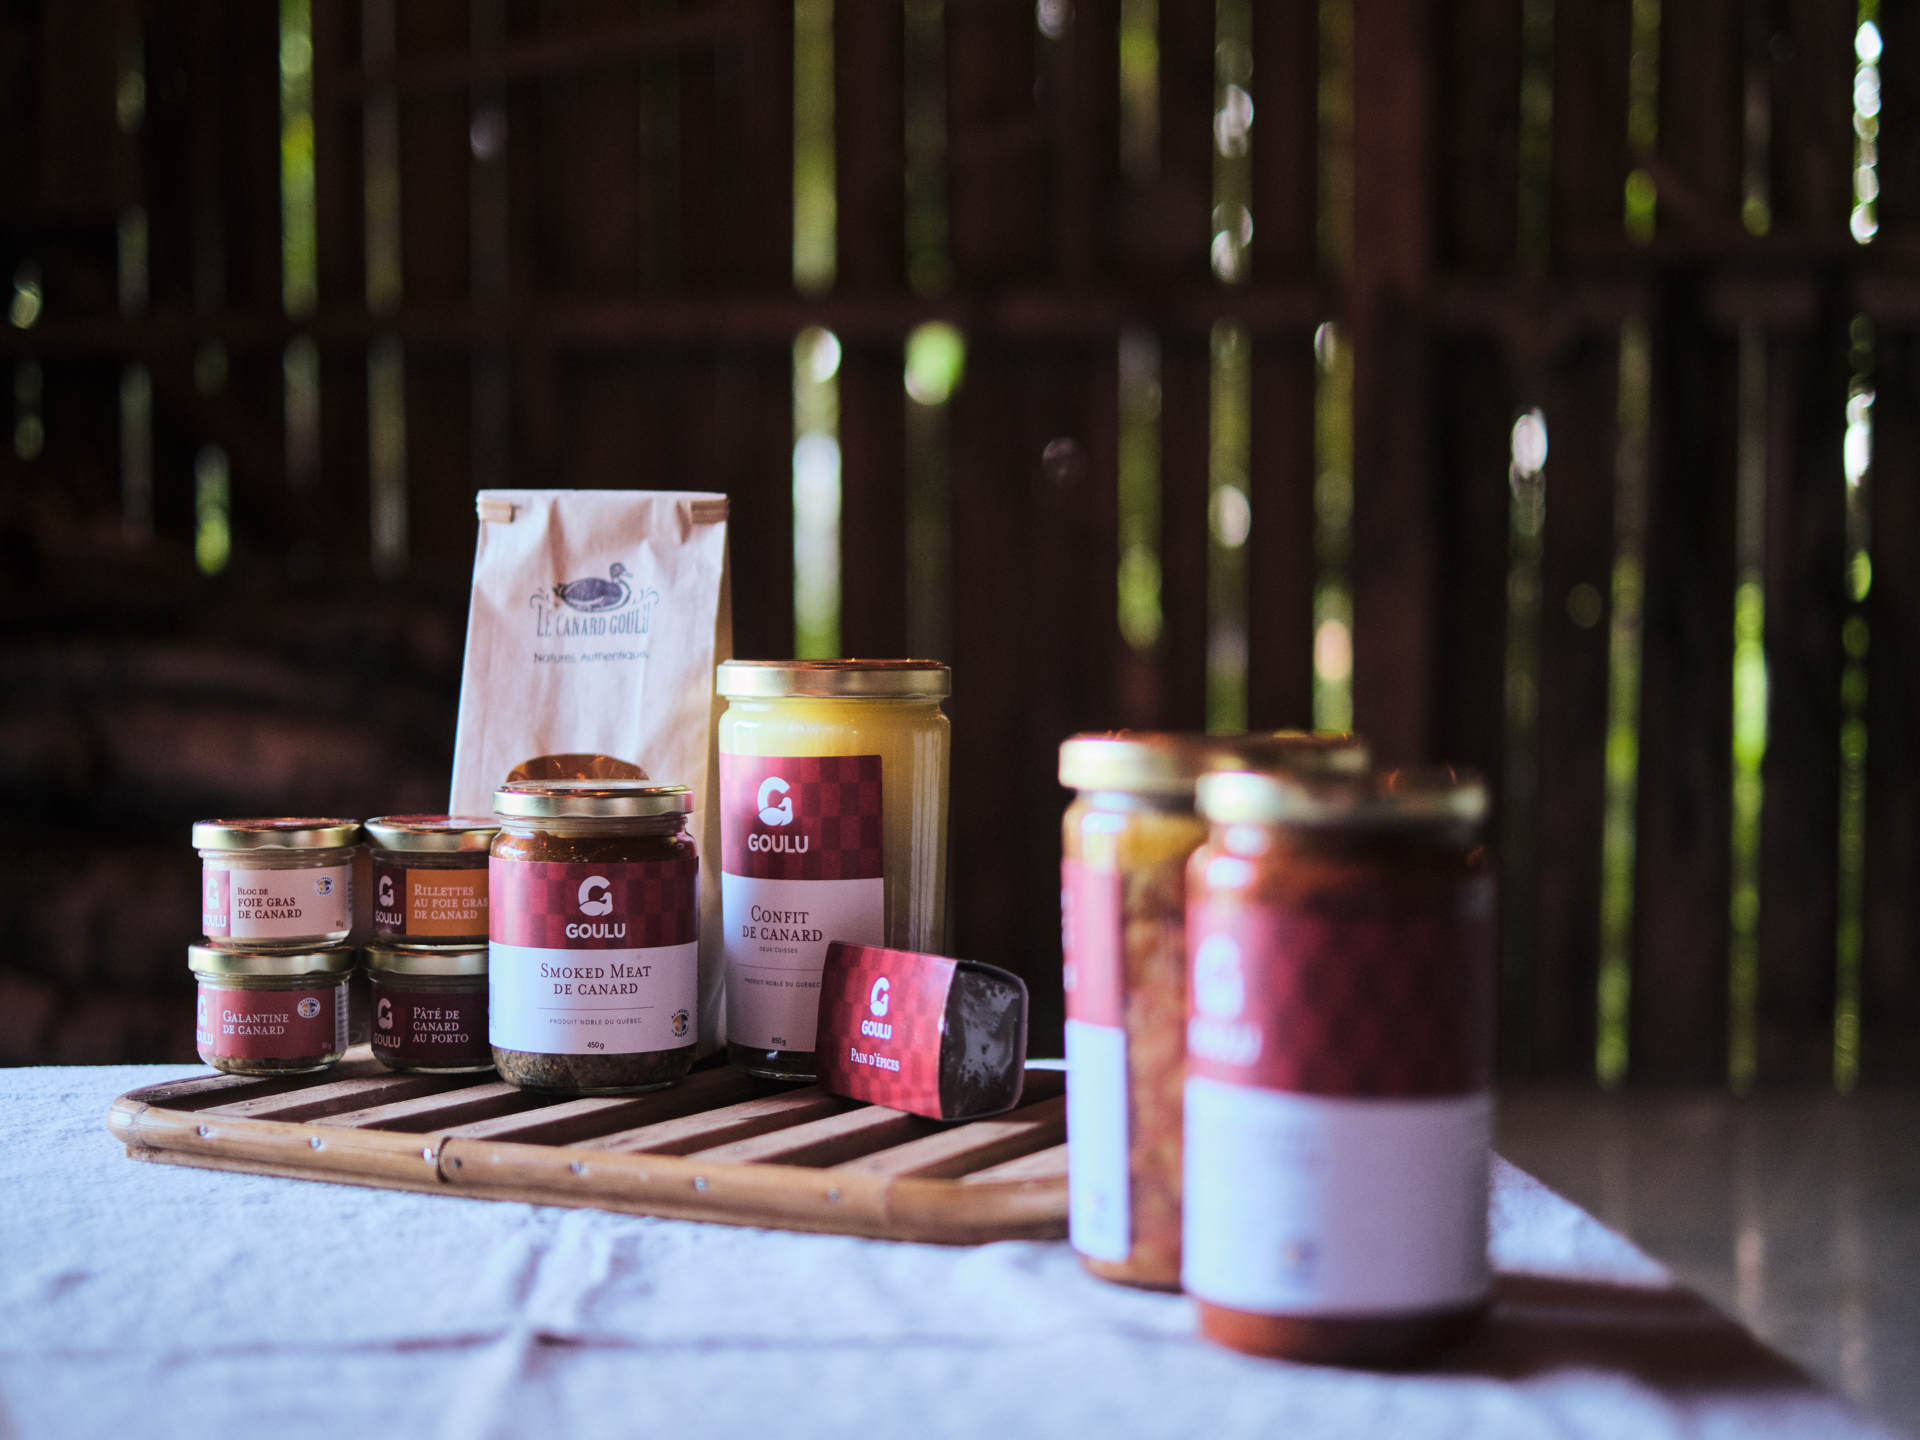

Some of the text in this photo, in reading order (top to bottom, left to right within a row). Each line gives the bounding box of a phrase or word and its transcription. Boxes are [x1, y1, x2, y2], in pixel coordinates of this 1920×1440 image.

[556, 616, 606, 636] CANARD
[609, 602, 651, 635] GOULU
[748, 833, 809, 853] GOULU
[238, 888, 269, 896] BLOC DE
[414, 884, 474, 896] RILLETTES
[238, 897, 296, 907] FOIE GRAS
[414, 898, 489, 908] AU FOIE GRAS
[238, 909, 302, 919] DE CANARD
[414, 910, 478, 920] DE CANARD
[751, 905, 809, 924] CONFIT
[565, 923, 626, 939] GOULU
[742, 925, 823, 942] DE CANARD
[540, 963, 652, 979] SMOKED MEAT
[554, 983, 638, 995] DE CANARD
[223, 1010, 289, 1023] GALANTINE
[413, 1007, 460, 1019] PÂTÉ DE
[223, 1025, 285, 1035] DE CANARD
[413, 1021, 459, 1031] CANARD
[861, 1020, 892, 1040] GOULU
[413, 1033, 469, 1044] AU PORTO
[851, 1047, 868, 1064] PAIN
